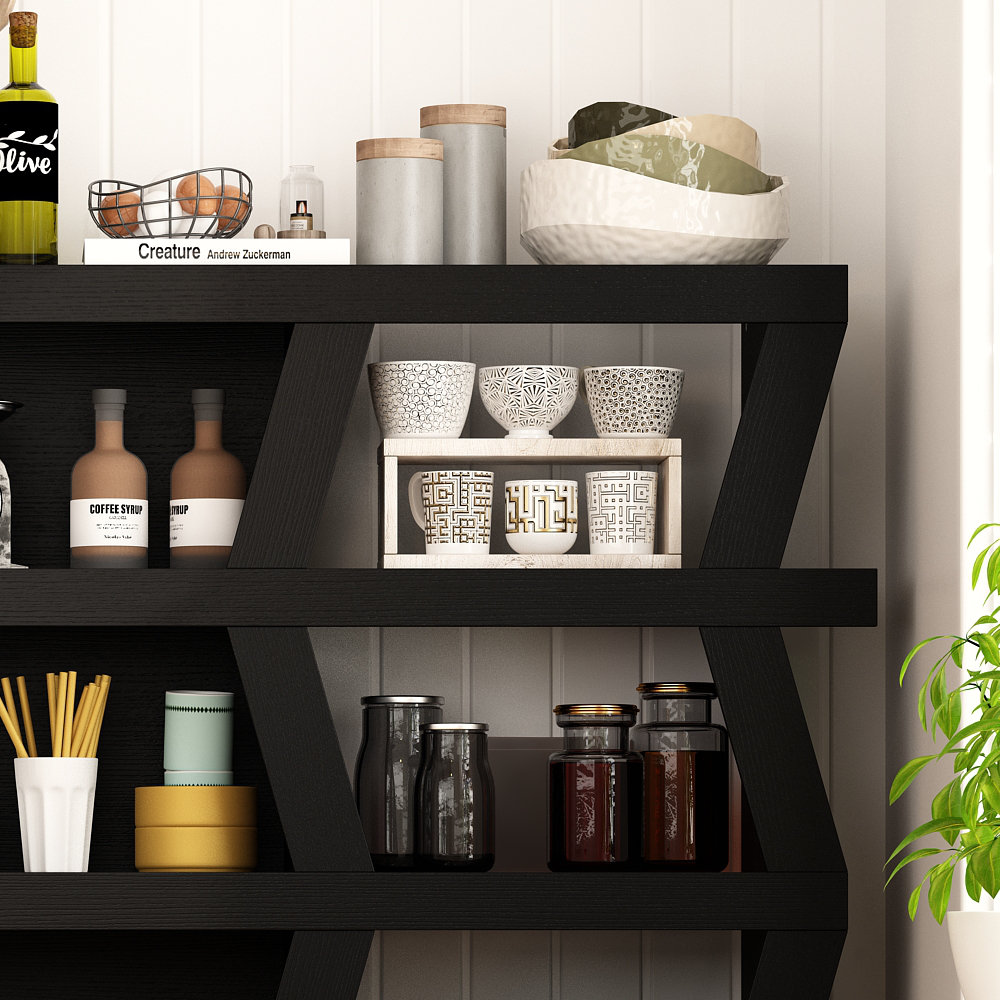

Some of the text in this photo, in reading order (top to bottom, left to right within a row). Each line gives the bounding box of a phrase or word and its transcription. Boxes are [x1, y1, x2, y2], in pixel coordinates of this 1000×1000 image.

[138, 243, 291, 260] Creature Andrew Zuckerman
[90, 503, 143, 515] COFFEE SYRUP
[171, 504, 189, 515] SYRUP
